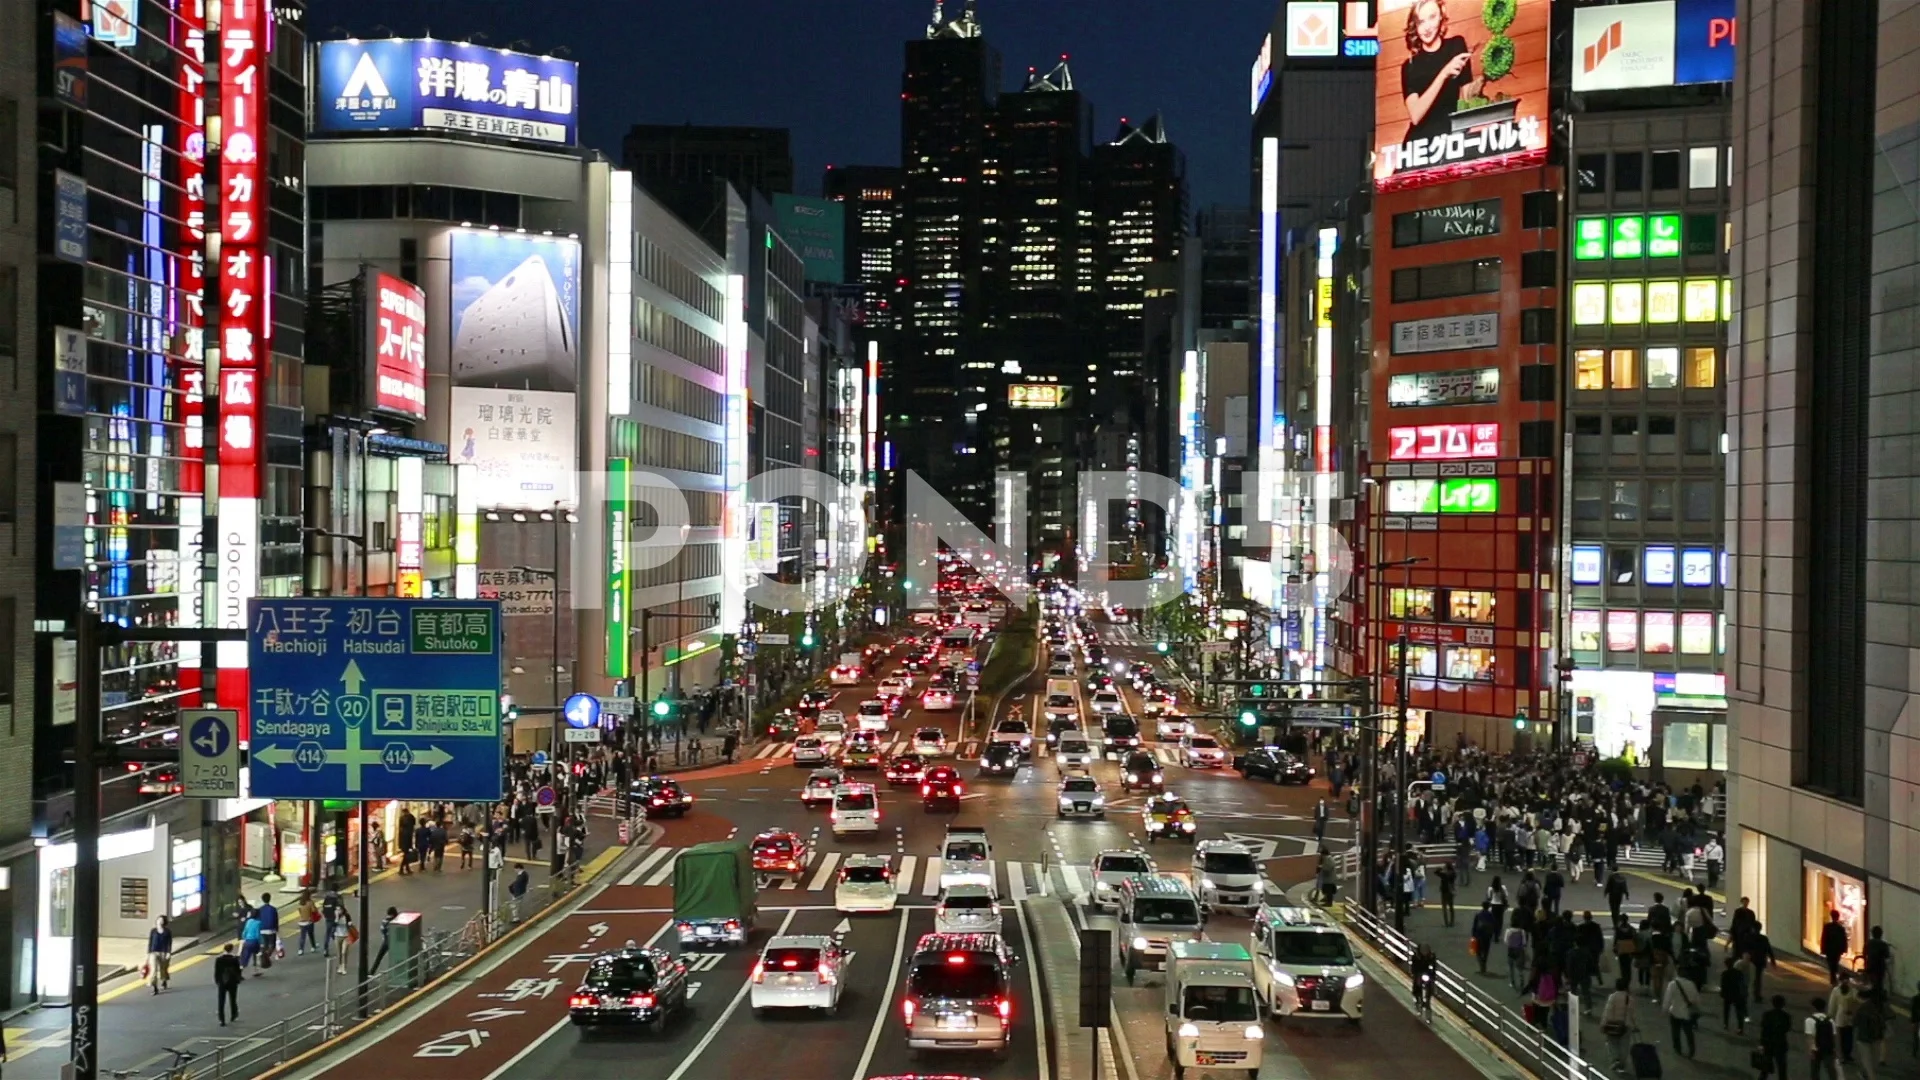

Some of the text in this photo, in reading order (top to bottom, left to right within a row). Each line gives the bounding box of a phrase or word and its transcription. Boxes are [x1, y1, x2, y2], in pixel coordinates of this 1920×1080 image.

[1709, 18, 1736, 48] P
[417, 57, 573, 115] 洋服の青山
[335, 97, 396, 111] 洋服の青山
[443, 111, 550, 138] 京王百貨店向い
[1381, 115, 1539, 171] THEグローバル社
[478, 404, 553, 425] 瑠璃光院
[1393, 427, 1468, 456] アコム
[1440, 483, 1491, 507] レイク
[255, 606, 402, 635] 八王子 初台
[415, 613, 488, 636] 首都高
[262, 637, 405, 656] Hachioji Hatsudai
[424, 637, 478, 651] Shutoko
[342, 703, 363, 718] 20
[415, 694, 493, 717] 新宿駅西口
[256, 719, 331, 739] Sendagaya
[416, 718, 459, 732] Shinjuku
[298, 749, 321, 764] 414
[385, 750, 408, 765] 414
